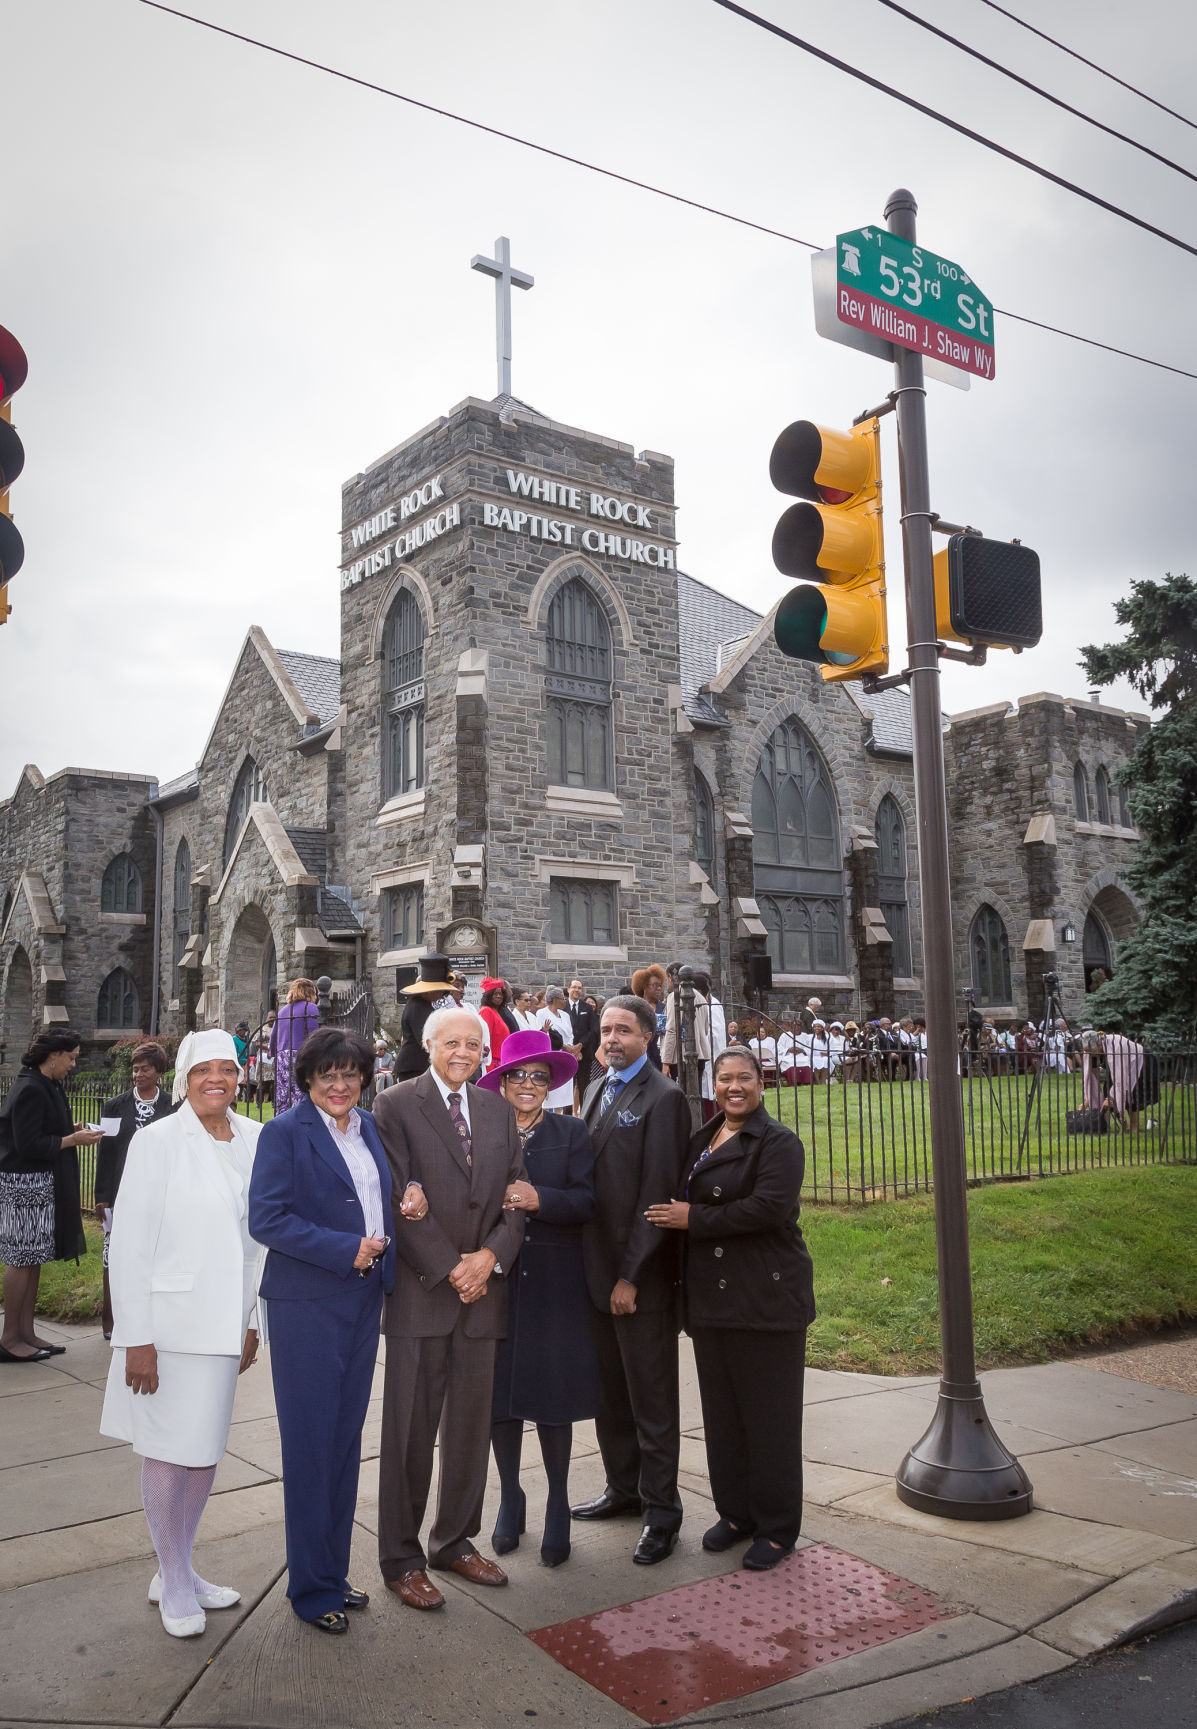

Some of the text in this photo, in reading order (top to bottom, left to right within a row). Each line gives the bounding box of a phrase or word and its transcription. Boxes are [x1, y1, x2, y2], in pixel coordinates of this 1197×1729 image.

[876, 234, 958, 281] 1 S 100
[879, 255, 989, 337] 53rd St
[840, 290, 992, 377] Rev William J. Shaw Wy
[351, 475, 444, 548] WHITE ROCK
[506, 469, 652, 529] WHITE ROCK
[341, 503, 461, 592] BAPTIST CHURCH
[483, 503, 674, 570] BAPTIST CHURCH
